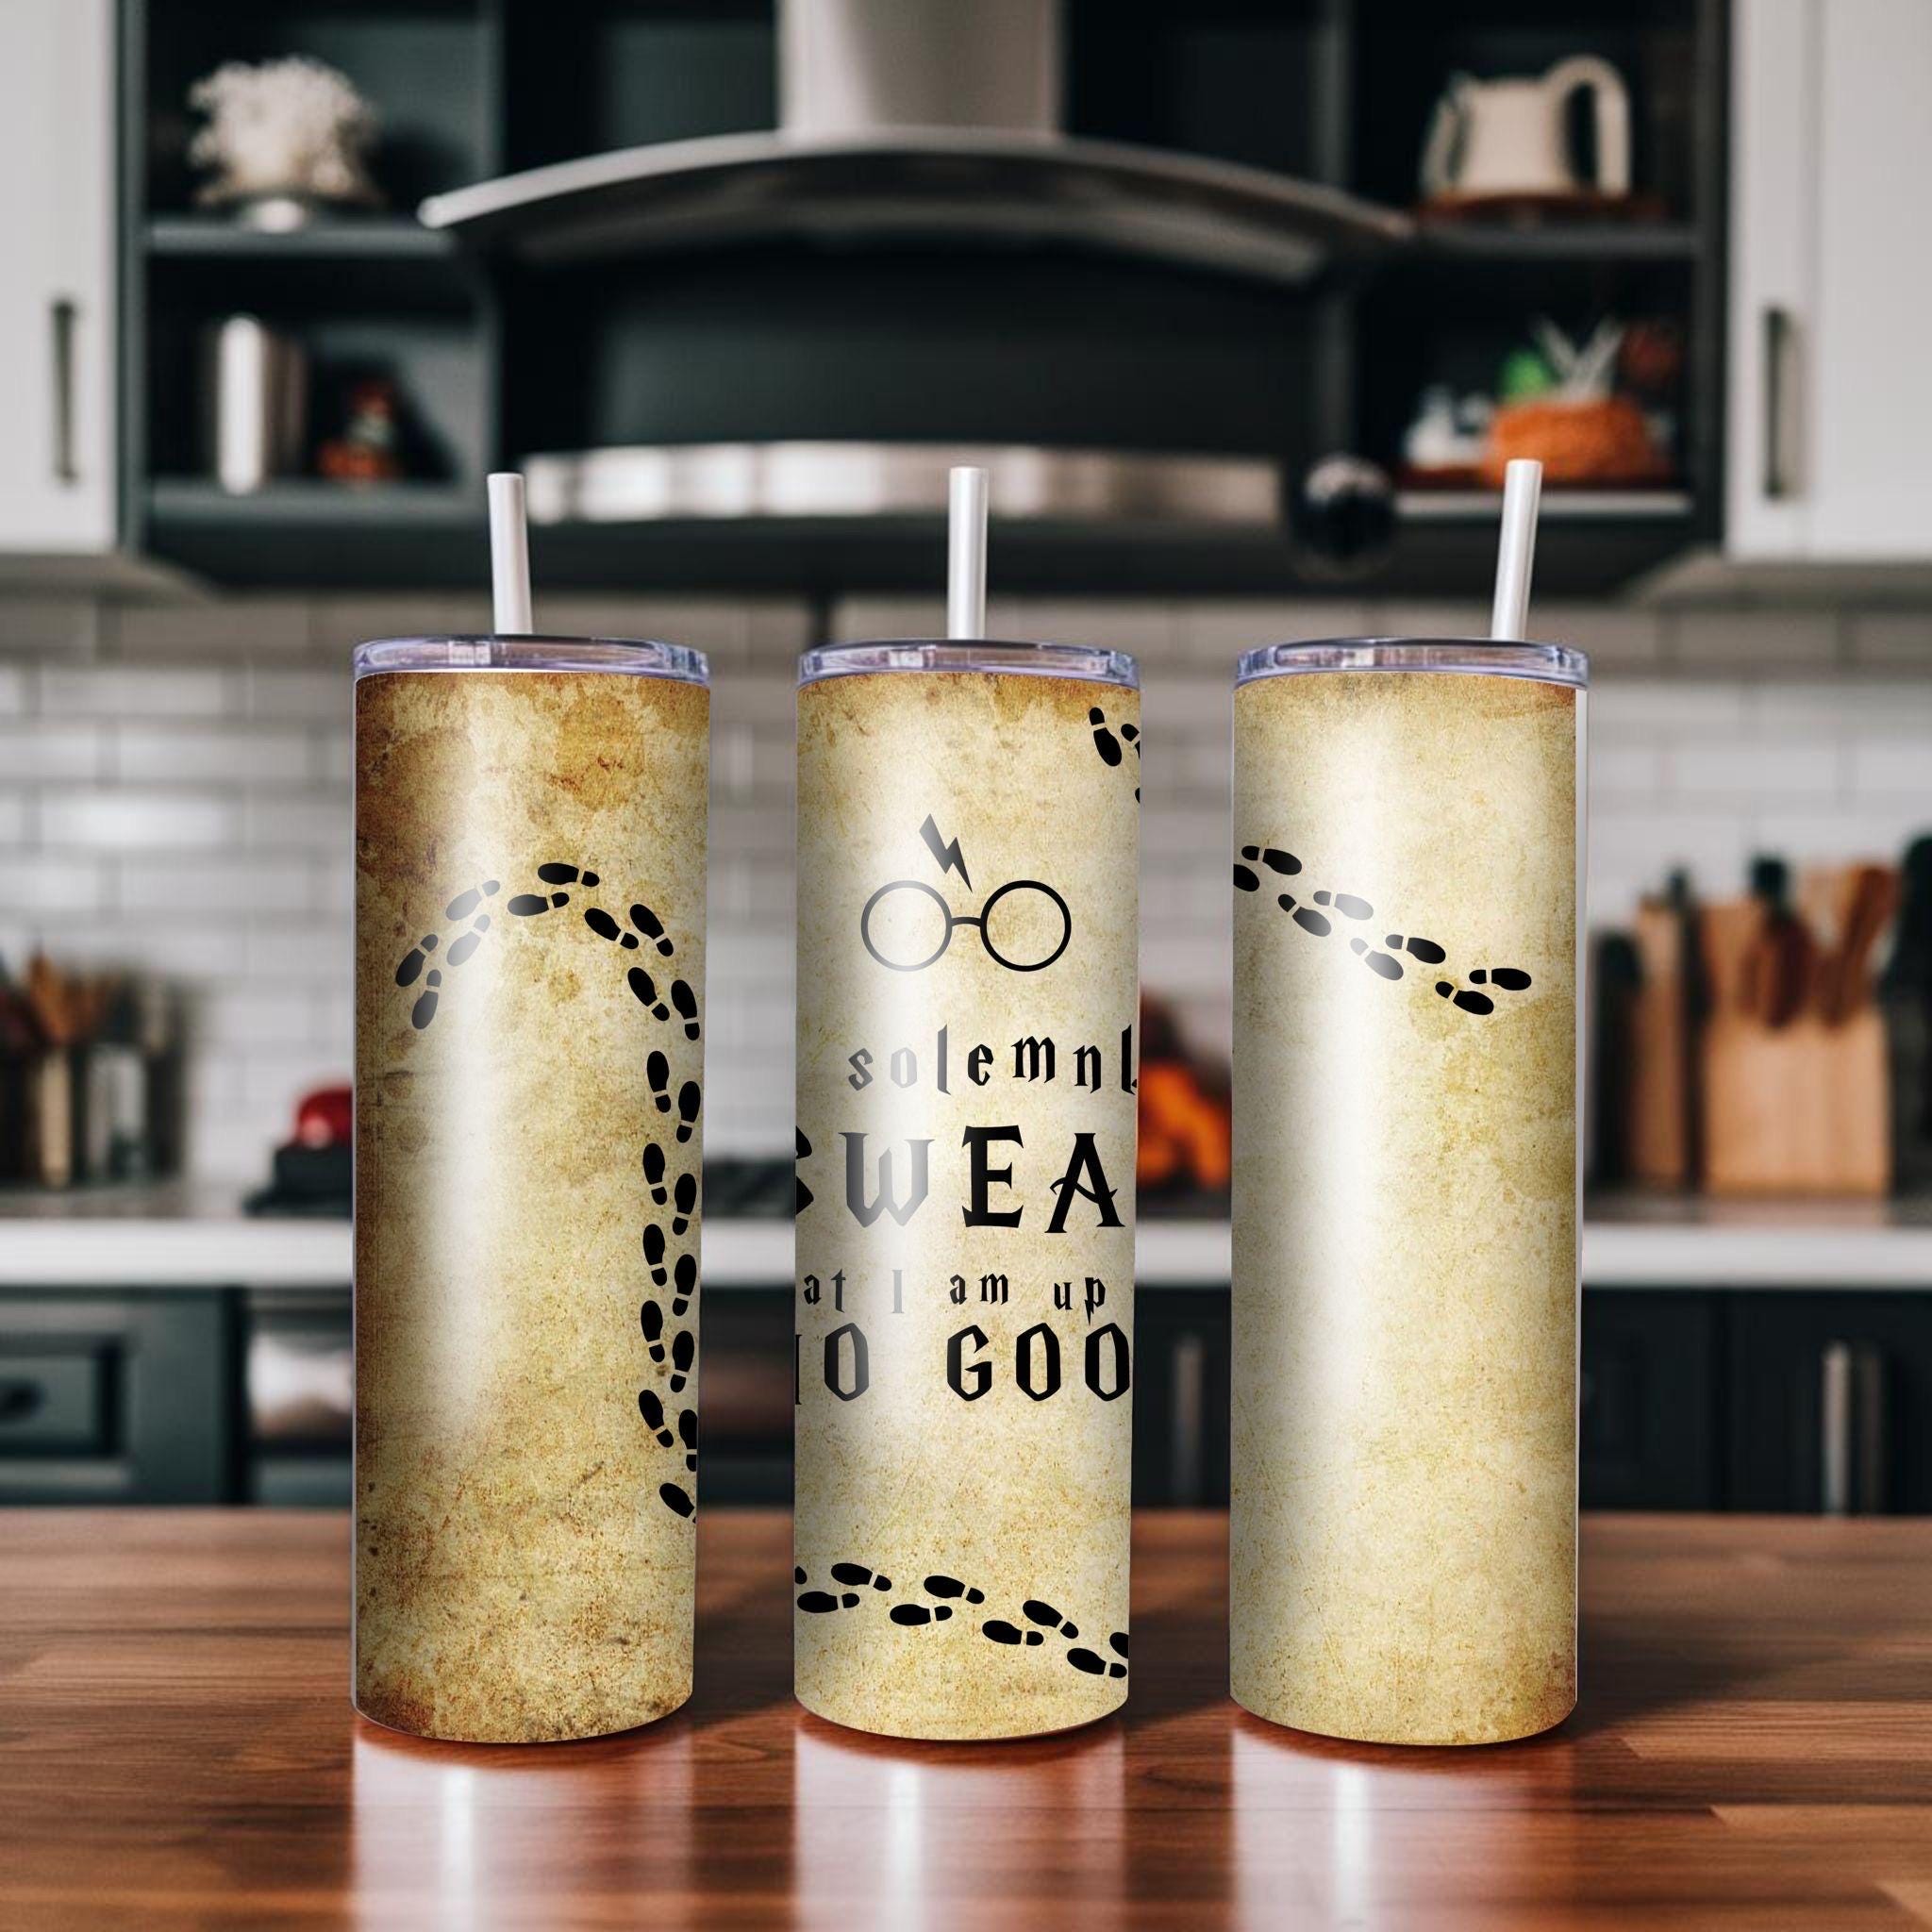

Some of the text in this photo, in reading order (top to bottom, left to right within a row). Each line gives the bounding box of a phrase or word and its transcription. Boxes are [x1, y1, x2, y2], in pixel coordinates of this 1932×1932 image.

[848, 1024, 1138, 1095] solemnl
[804, 1269, 846, 1312] at
[949, 1273, 1008, 1305] am
[1054, 1276, 1106, 1325] up
[795, 1322, 1130, 1405] O GOO
